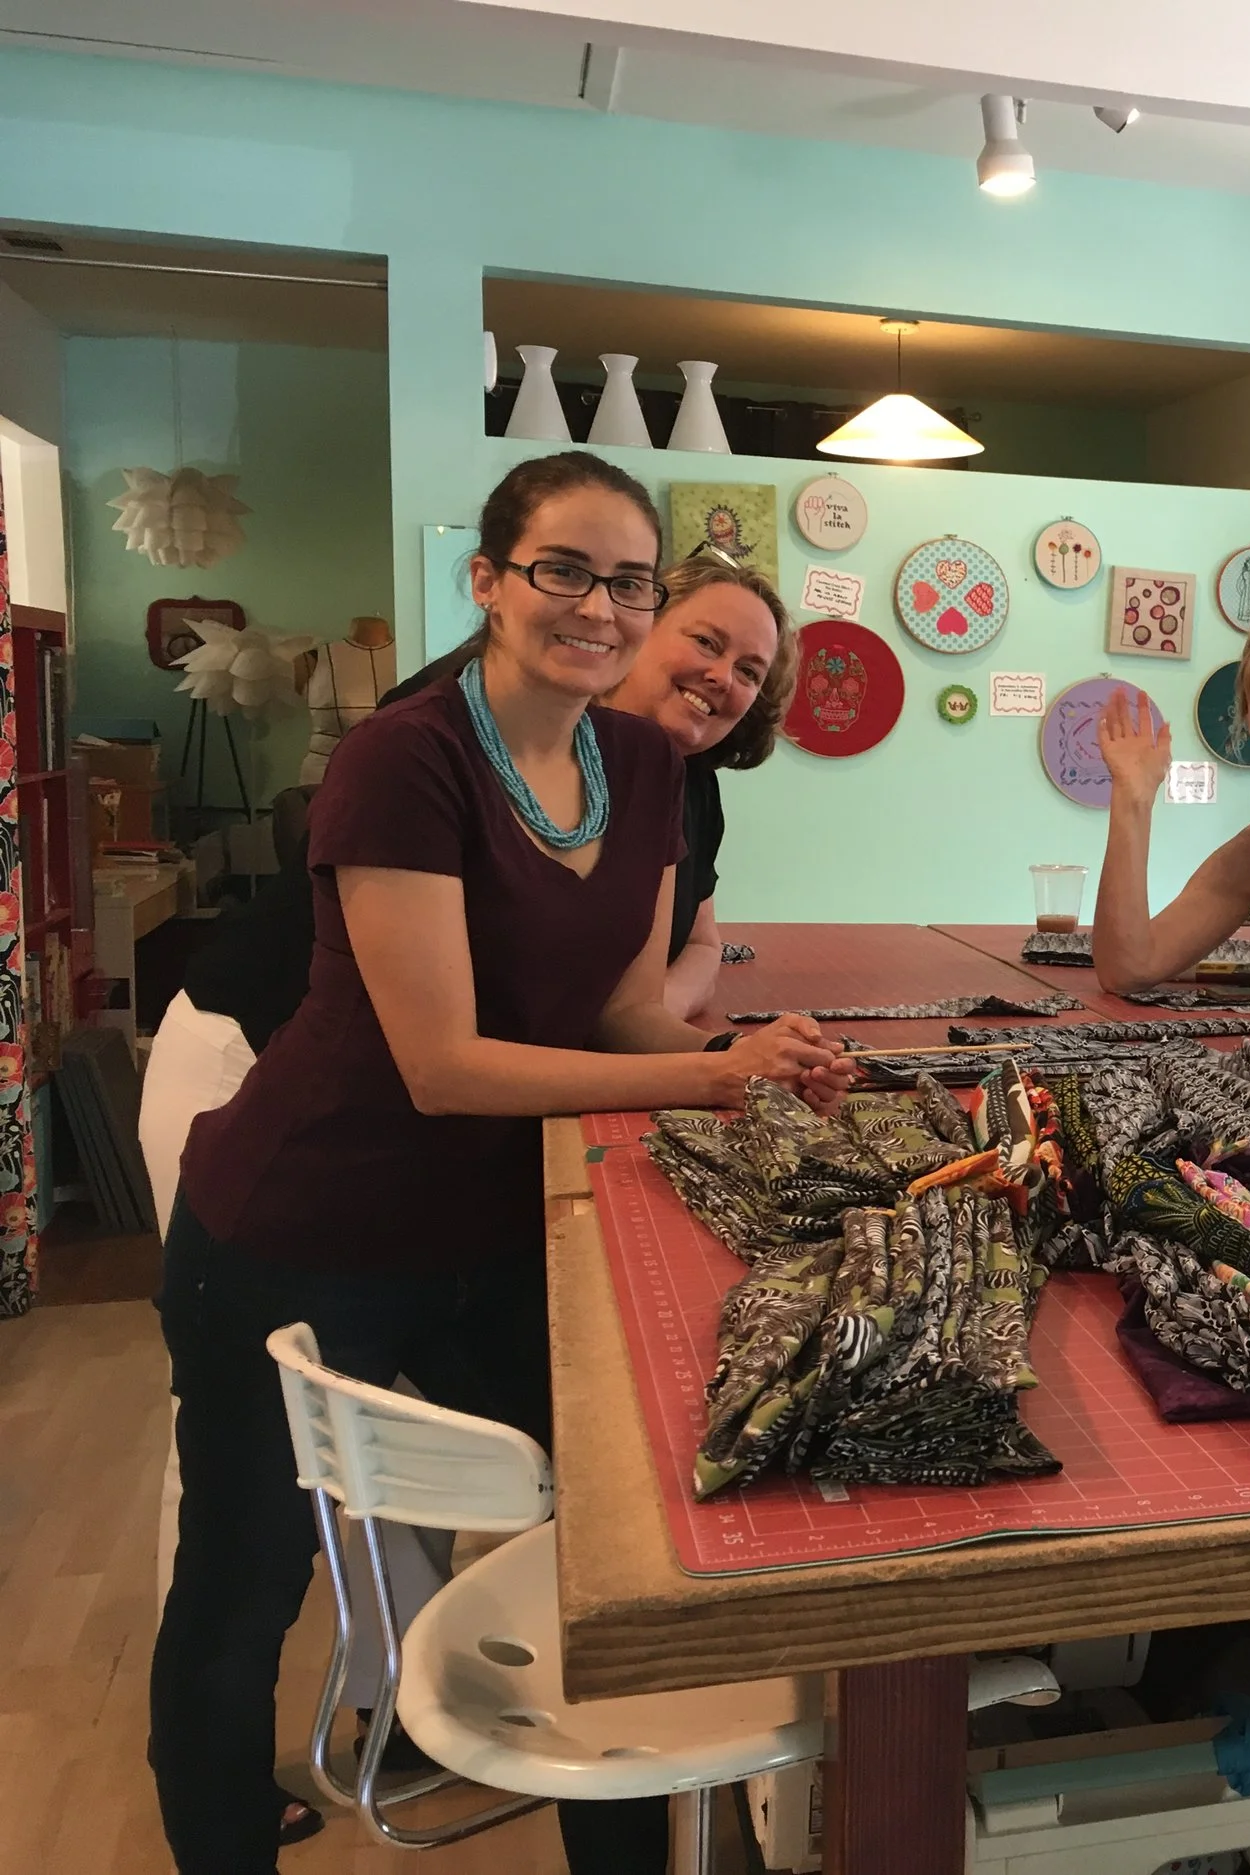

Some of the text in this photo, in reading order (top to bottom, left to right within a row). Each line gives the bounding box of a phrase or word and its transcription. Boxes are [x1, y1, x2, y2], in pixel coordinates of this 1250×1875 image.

[826, 503, 849, 513] viva
[832, 512, 842, 520] la
[823, 520, 851, 530] stitch
[722, 1531, 744, 1546] 35
